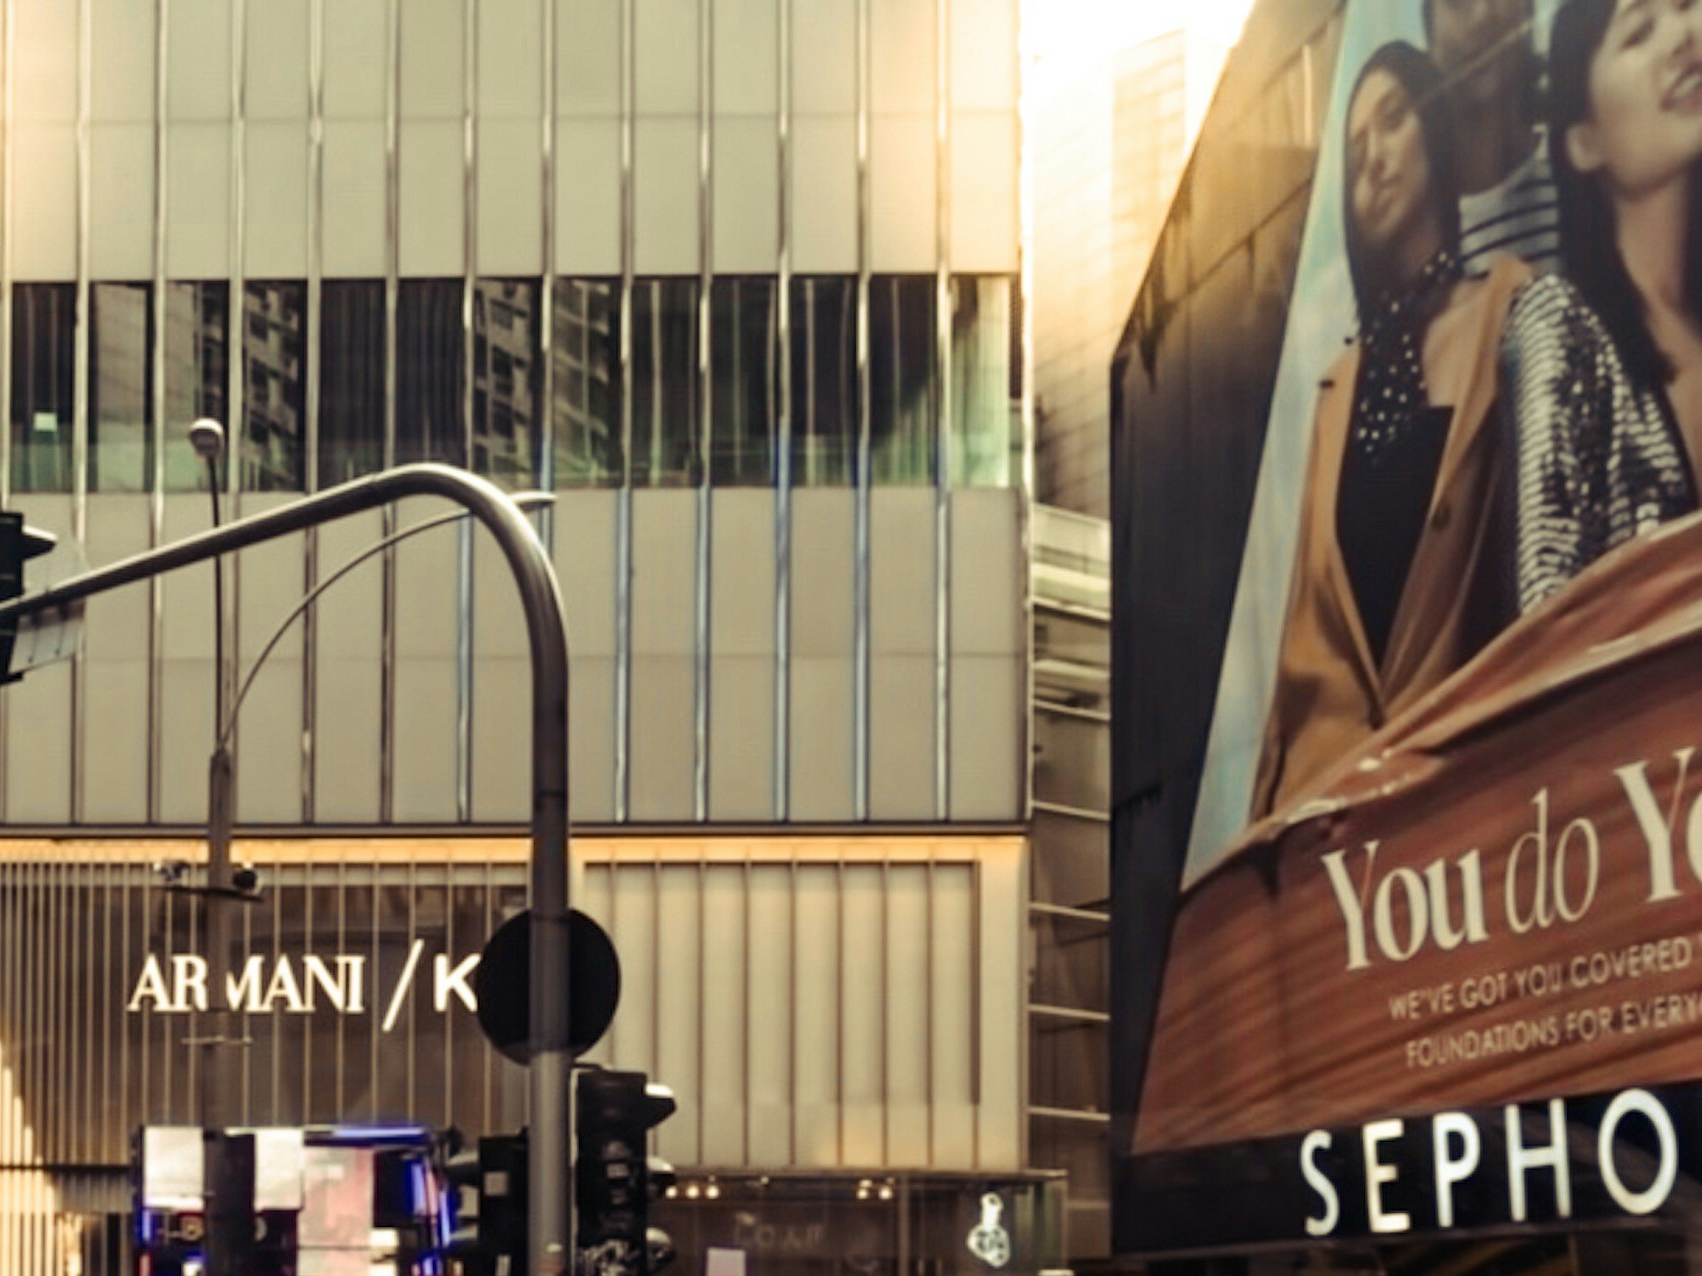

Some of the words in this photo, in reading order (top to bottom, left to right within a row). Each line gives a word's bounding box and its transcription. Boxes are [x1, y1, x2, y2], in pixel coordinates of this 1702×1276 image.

[1322, 841, 1489, 971] You
[1505, 787, 1599, 935] do
[1613, 746, 1702, 902] Y
[127, 953, 366, 1014] ARMANI
[1459, 971, 1507, 1009] GOT
[1514, 962, 1563, 997] YOU
[1570, 936, 1693, 987] COVERED
[1405, 1015, 1560, 1068] FOUNDATIONS
[1566, 1006, 1614, 1041] FOR
[1621, 991, 1702, 1034] EVERY
[1300, 1088, 1678, 1237] SEPHO
